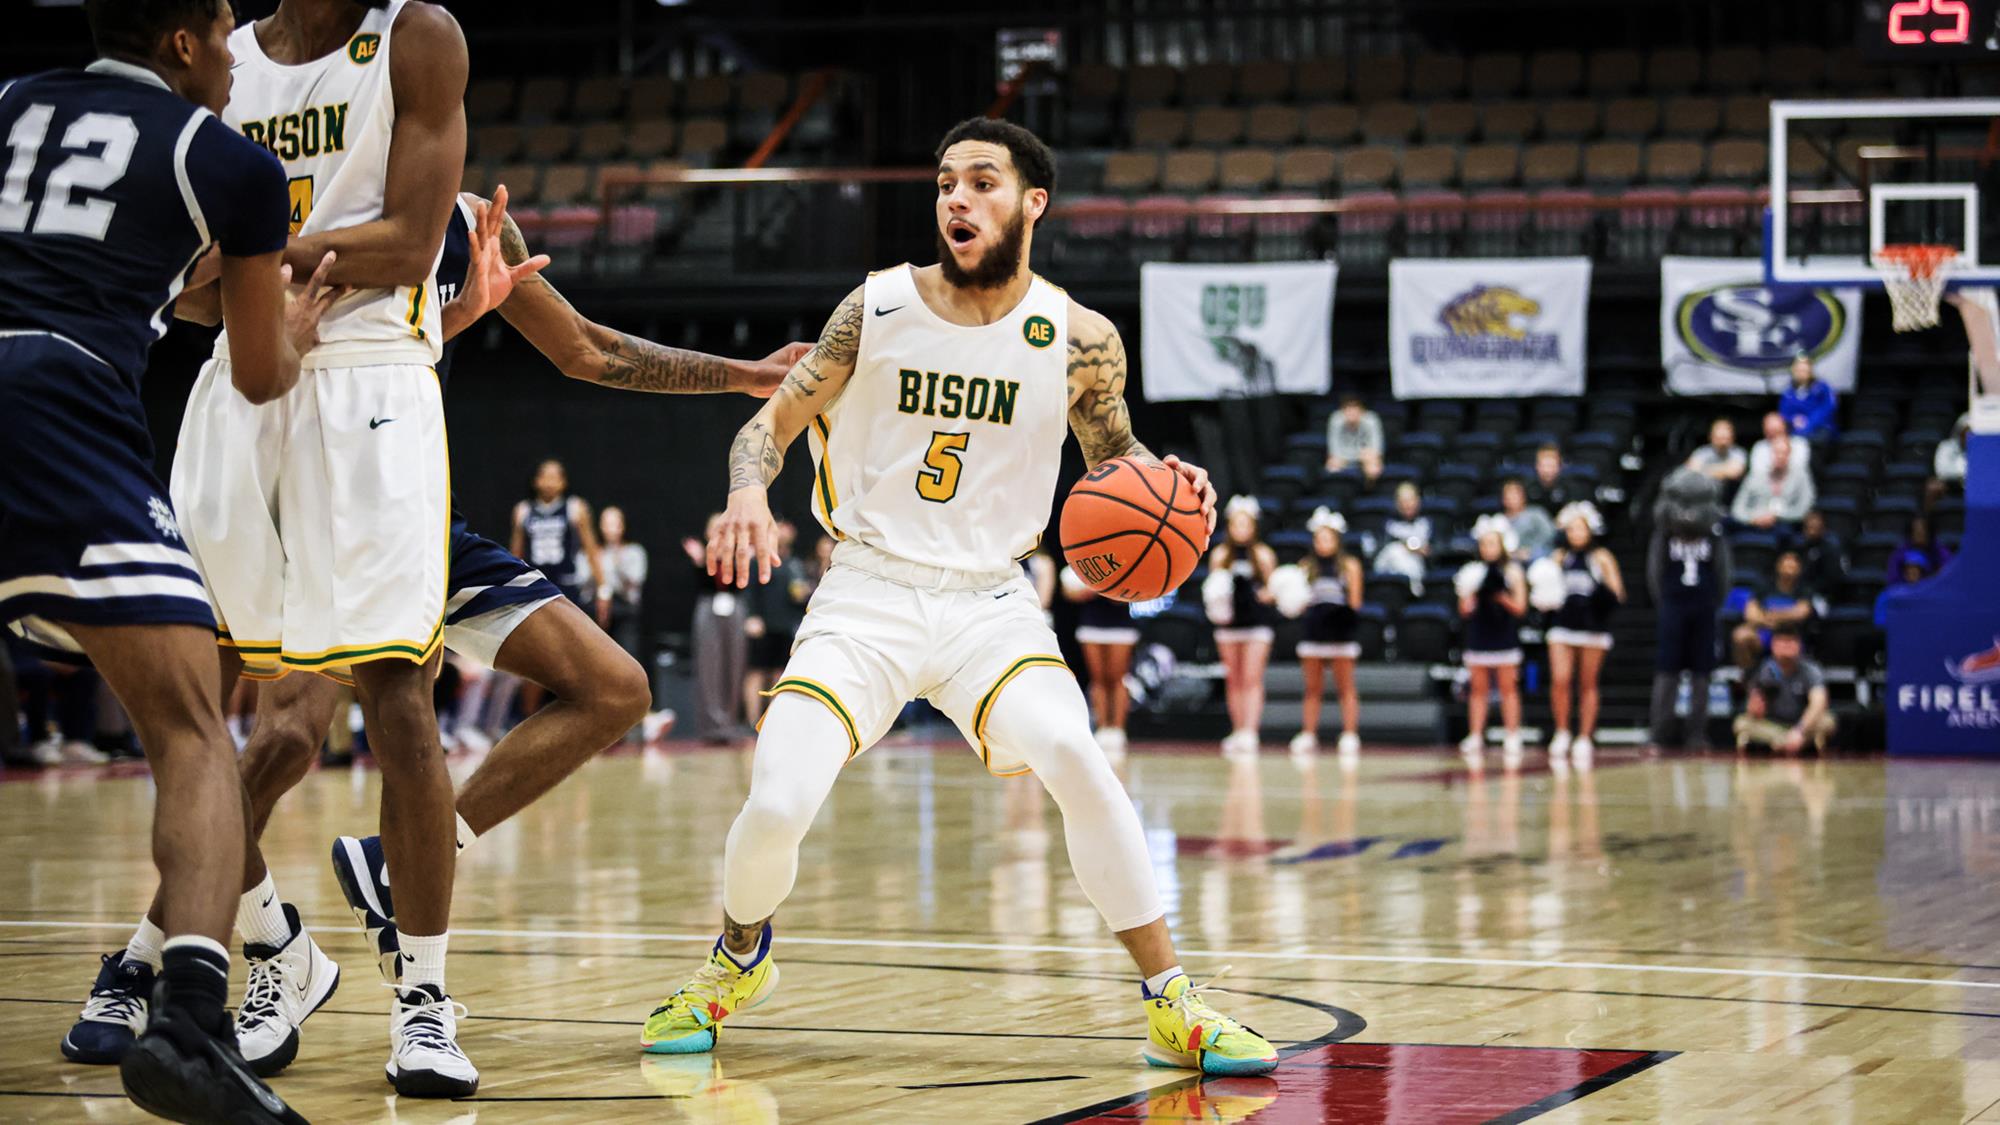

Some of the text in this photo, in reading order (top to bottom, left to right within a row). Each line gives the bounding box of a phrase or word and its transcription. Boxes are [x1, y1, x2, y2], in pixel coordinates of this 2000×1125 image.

[355, 37, 377, 59] AE
[0, 103, 140, 241] 12
[1028, 322, 1050, 342] AE
[898, 368, 1020, 426] BISON
[915, 430, 970, 504] 5
[1076, 552, 1122, 585] ROCK
